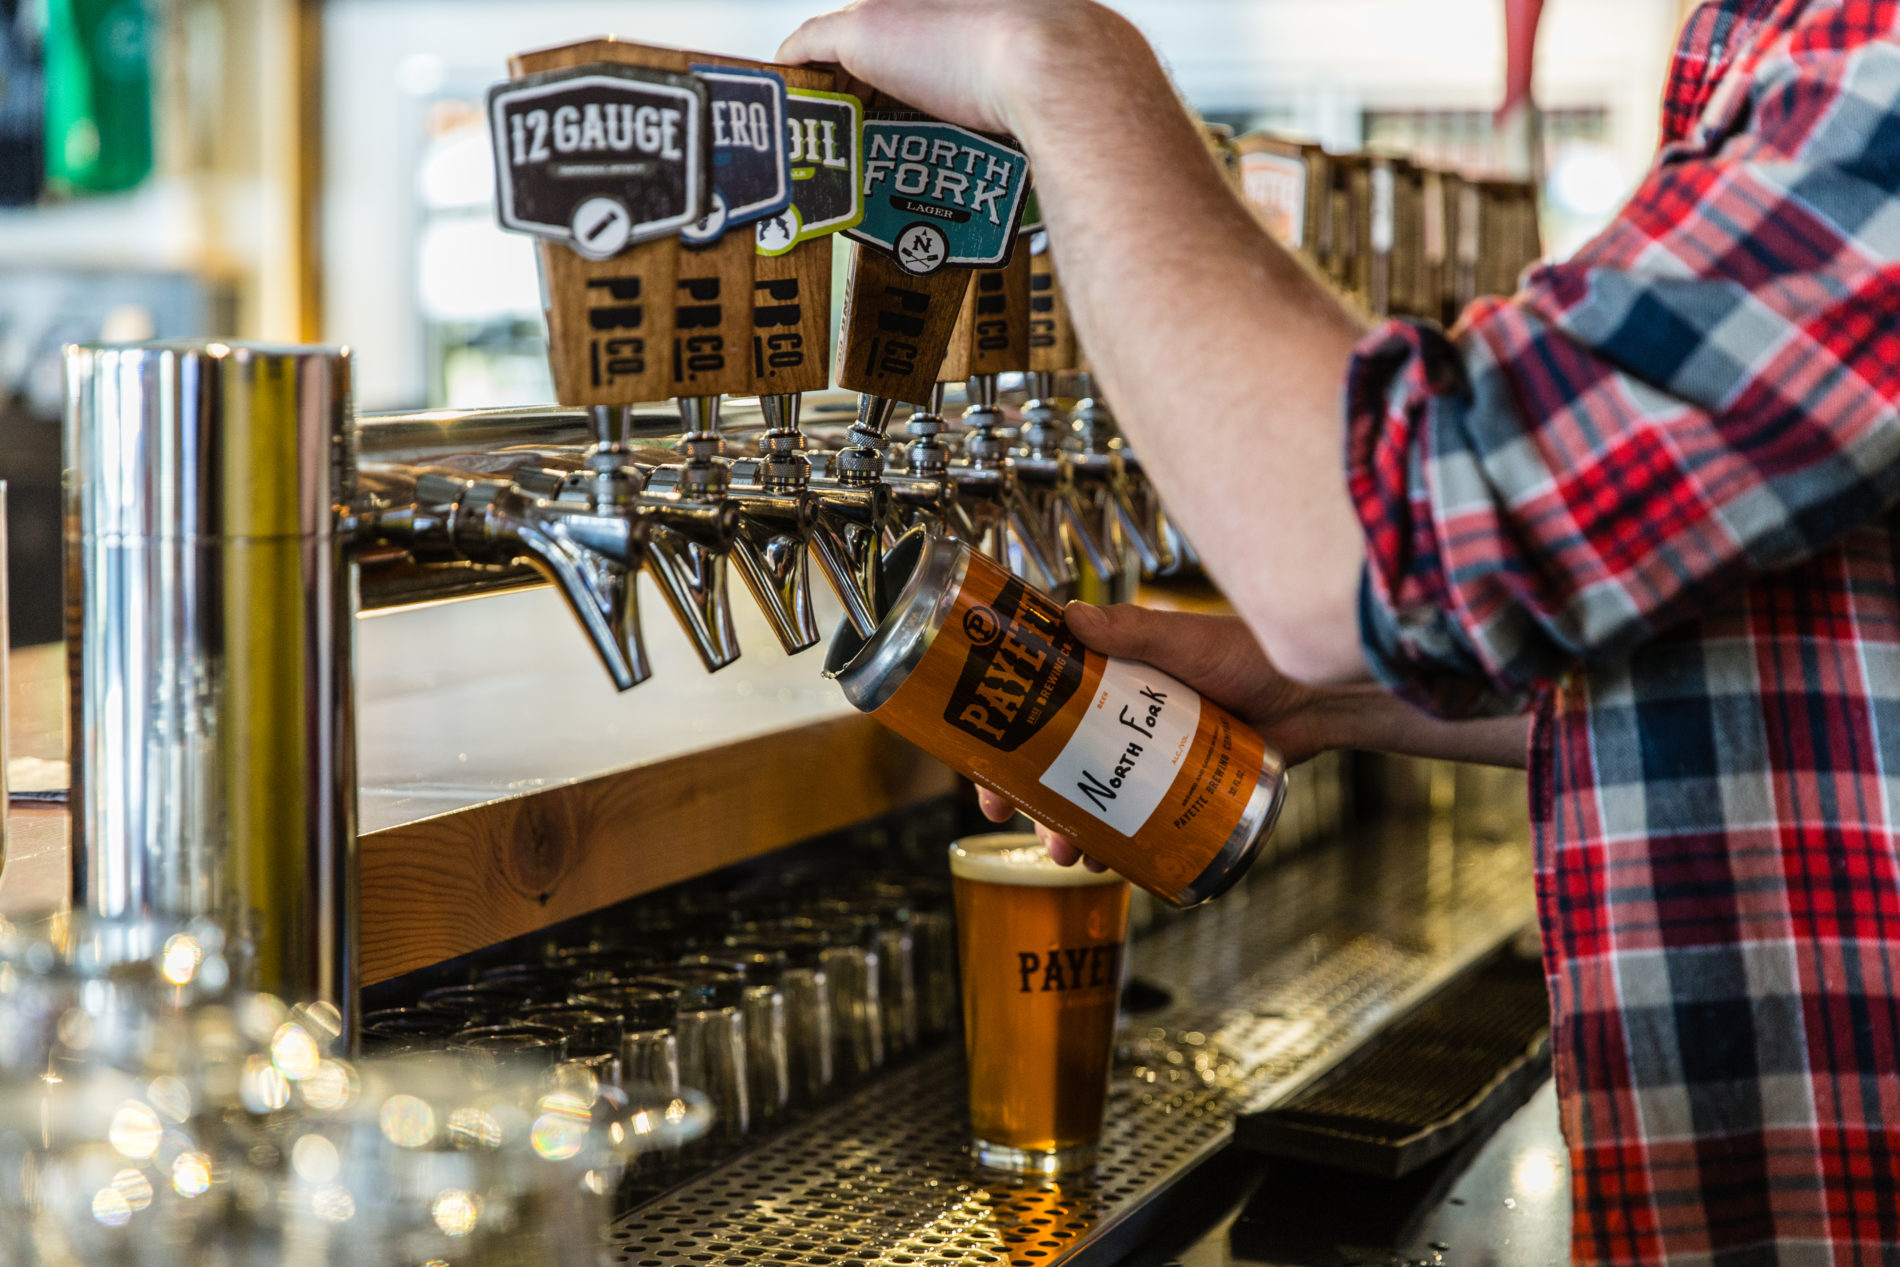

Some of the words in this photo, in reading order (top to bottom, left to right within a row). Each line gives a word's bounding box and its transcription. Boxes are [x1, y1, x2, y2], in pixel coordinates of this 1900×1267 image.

[510, 109, 551, 166] 12
[553, 103, 684, 160] GAUGE
[868, 133, 1013, 188] NORTH
[863, 159, 1008, 227] FORK
[907, 201, 954, 220] LAGER
[1036, 655, 1067, 707] BREWING
[1173, 794, 1209, 830] PAYETTE
[1205, 753, 1230, 795] BREWING
